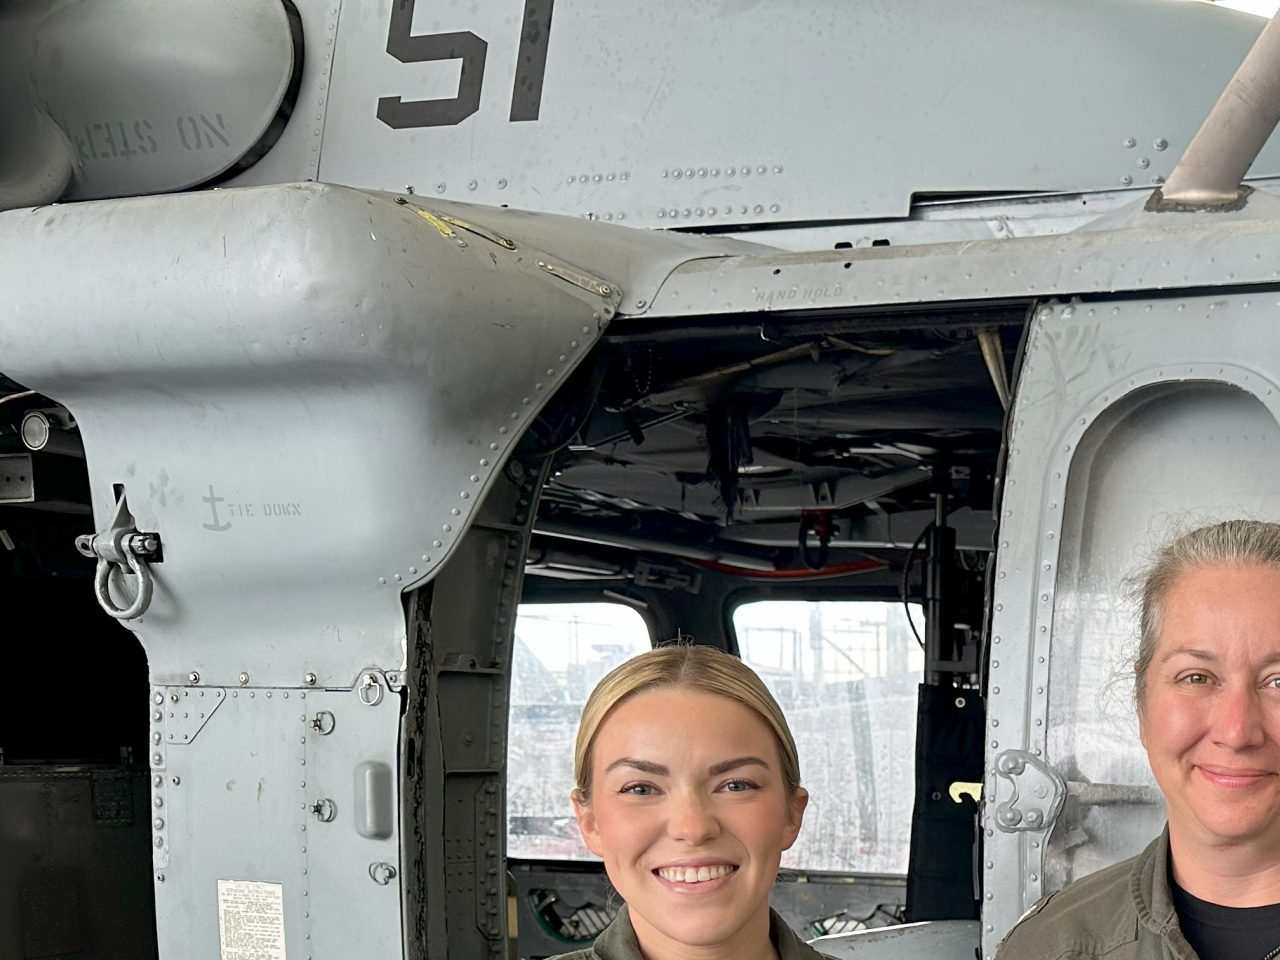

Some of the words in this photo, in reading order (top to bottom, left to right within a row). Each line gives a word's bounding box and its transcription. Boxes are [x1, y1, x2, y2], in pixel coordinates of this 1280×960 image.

[177, 113, 230, 150] NO
[755, 289, 797, 302] HAND
[803, 287, 843, 298] HOLD
